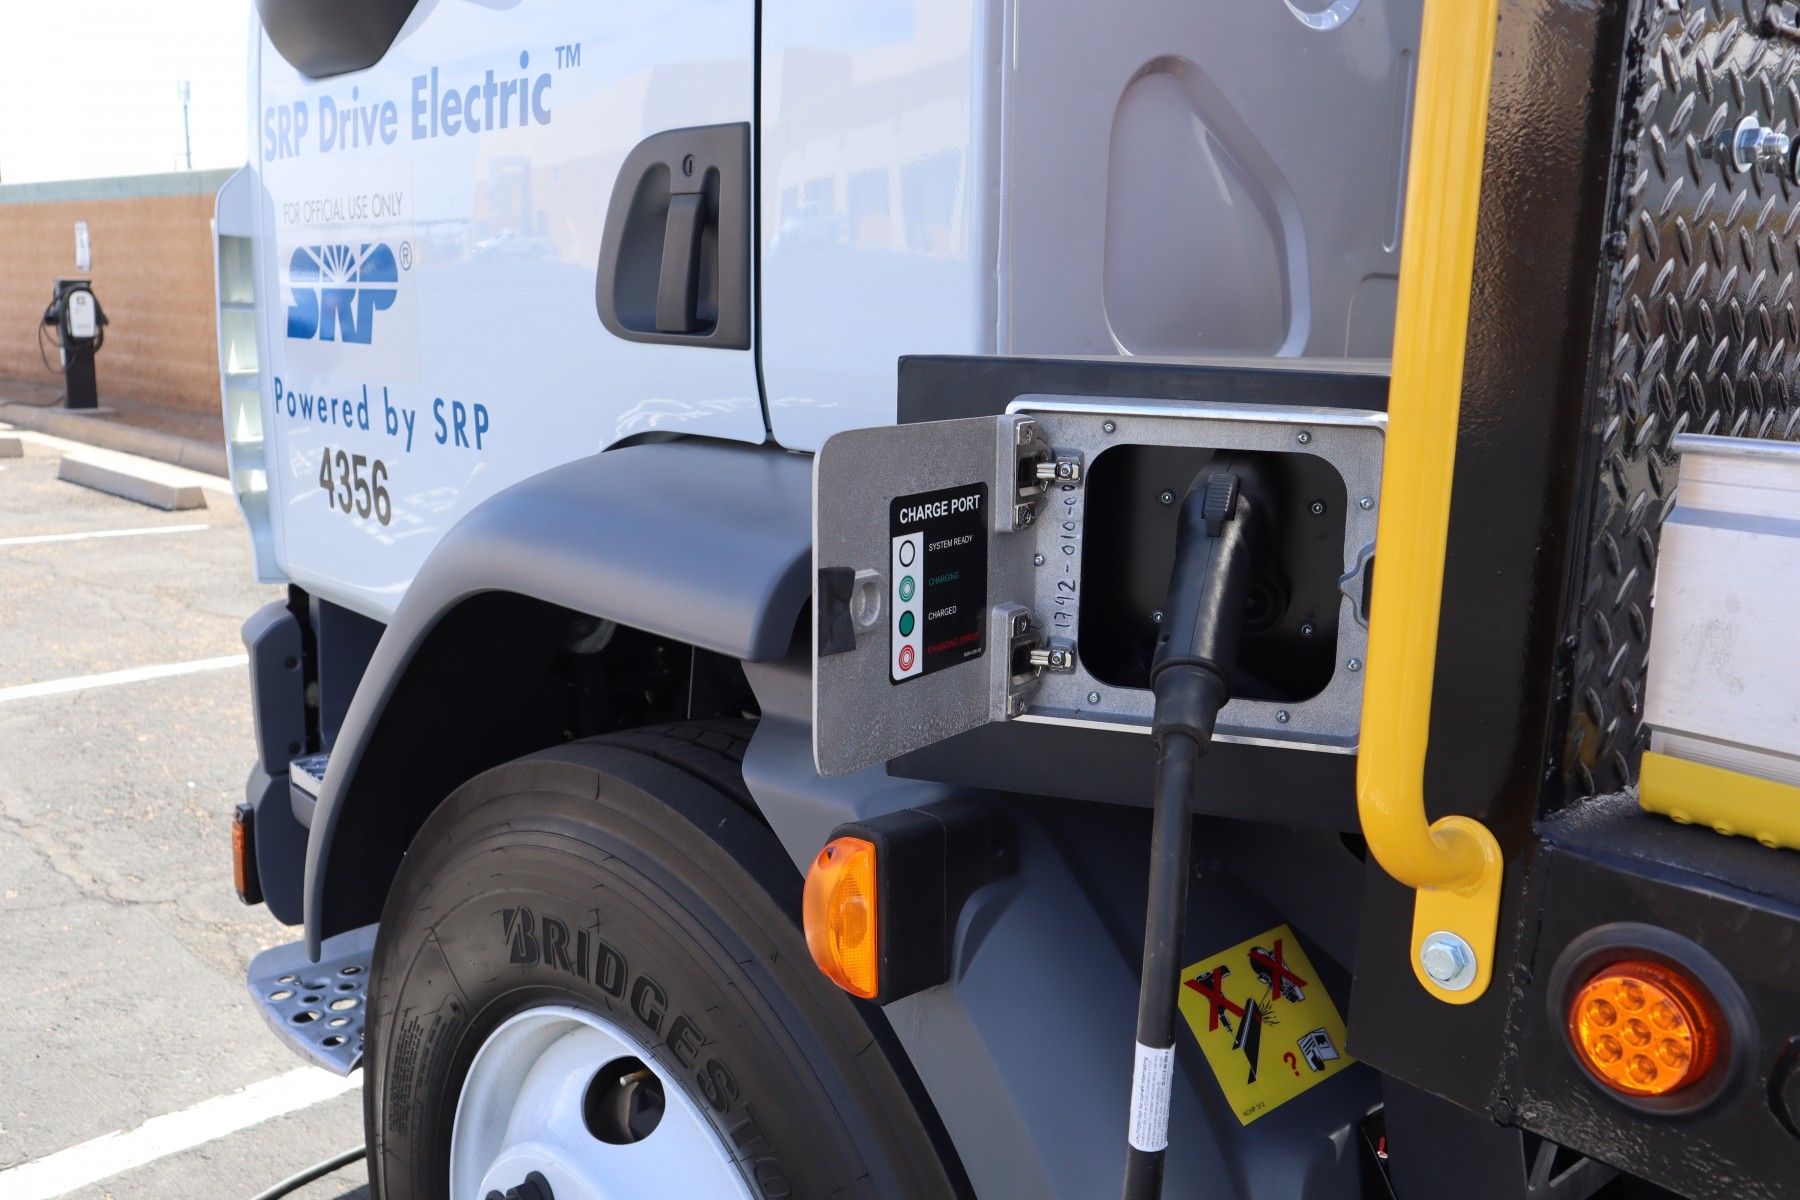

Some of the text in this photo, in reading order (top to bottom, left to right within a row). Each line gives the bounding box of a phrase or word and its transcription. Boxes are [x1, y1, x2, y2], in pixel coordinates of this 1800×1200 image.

[264, 100, 309, 162] SRP
[318, 85, 398, 153] Drive
[283, 191, 403, 224] FOR OFFICIAL USE ONLY
[287, 242, 398, 344] SRP
[274, 376, 489, 452] Powered by SRP
[319, 447, 391, 526] 4356
[900, 494, 980, 524] CHARGE PORT
[928, 534, 973, 552] SYSTEM READY
[928, 571, 960, 587] CHARGING
[928, 605, 957, 620] CHARGED
[928, 638, 959, 655] CHARGING
